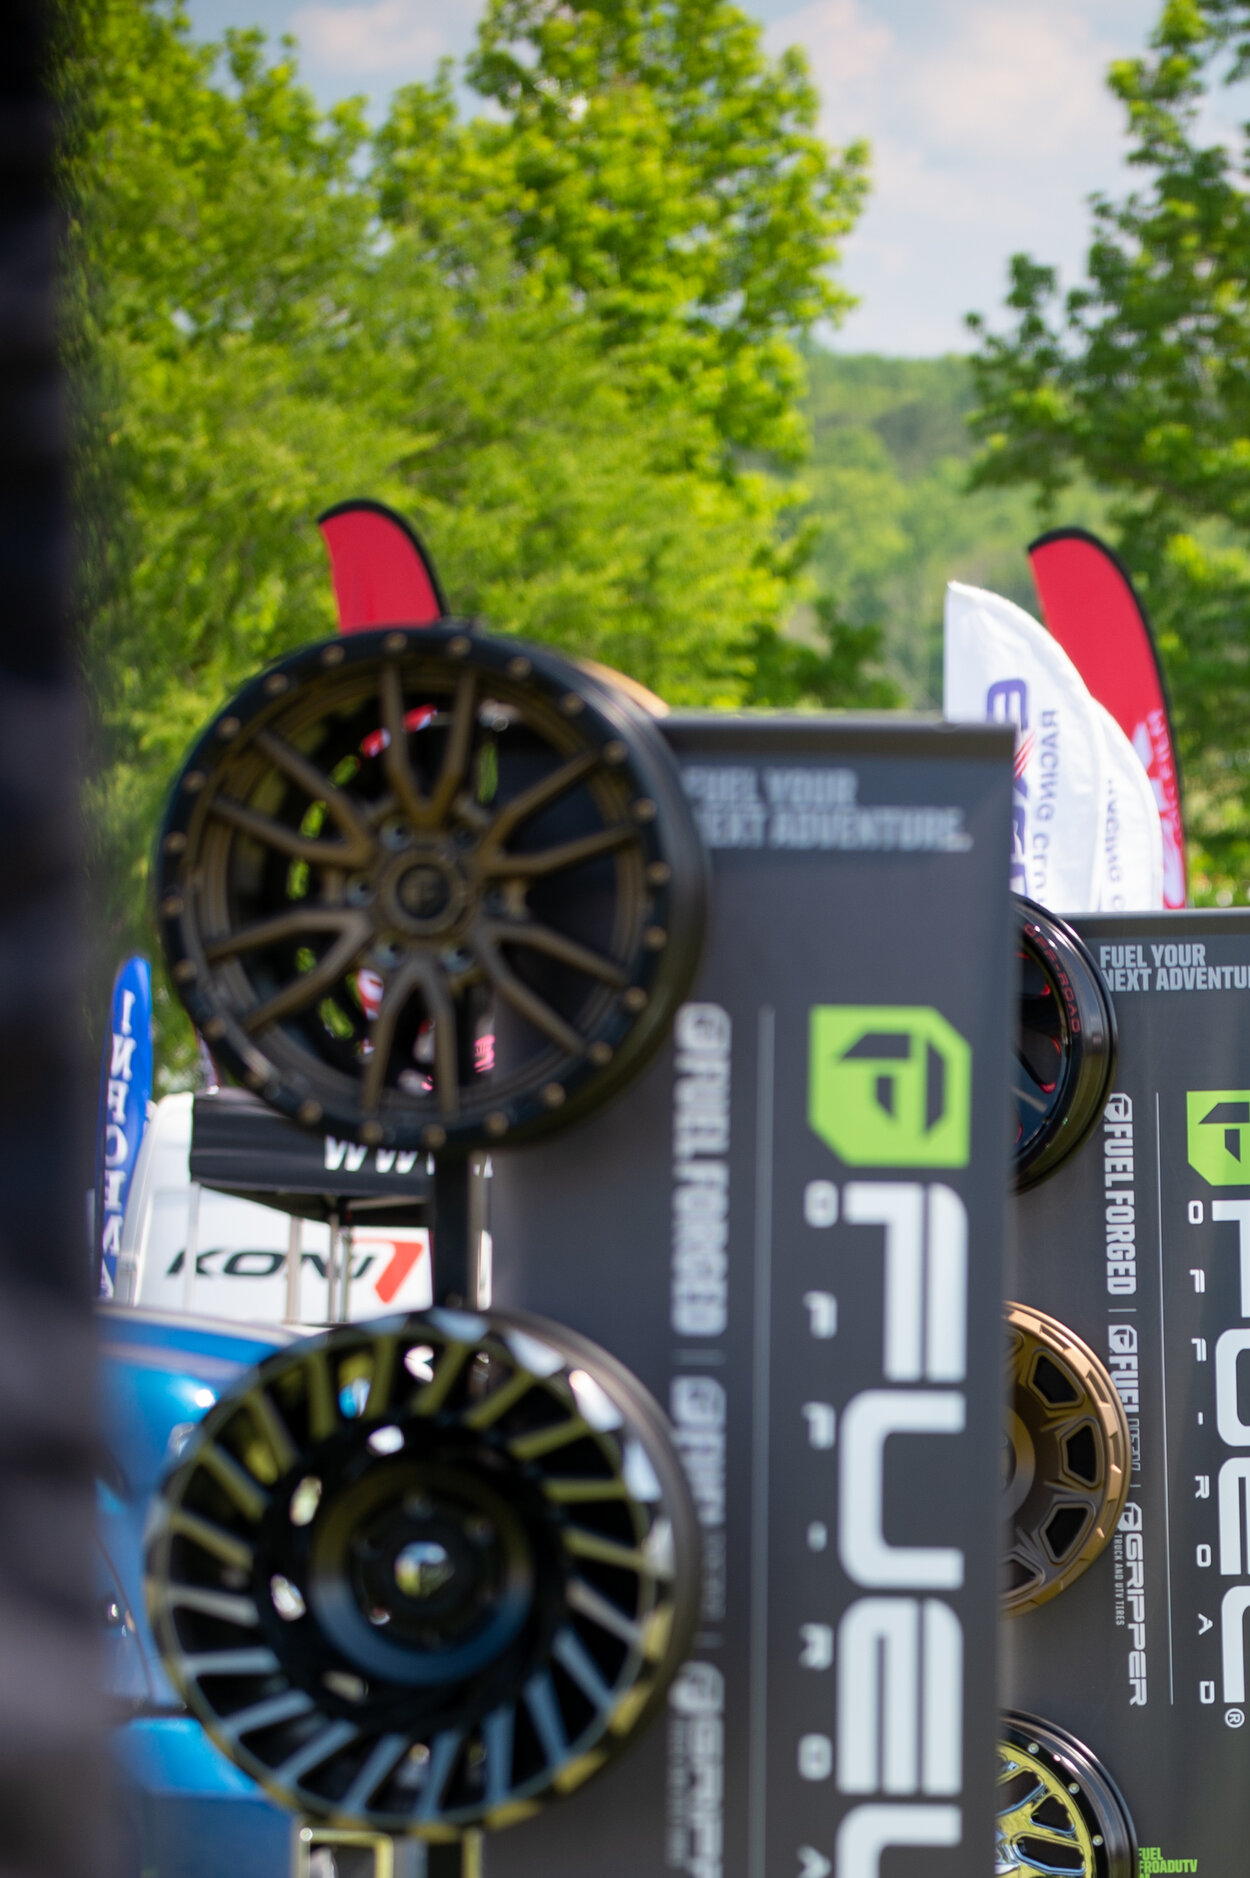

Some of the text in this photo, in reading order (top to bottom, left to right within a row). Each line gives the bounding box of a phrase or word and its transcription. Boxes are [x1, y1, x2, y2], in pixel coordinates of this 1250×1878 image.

[1100, 943, 1206, 969] FUEL YOUR
[1103, 1123, 1137, 1296] FUEL FORGED
[1114, 1563, 1124, 1580] AND
[1115, 1582, 1125, 1598] UTV
[1115, 1600, 1125, 1626] TIRES
[1125, 1533, 1148, 1706] GRIPPER
